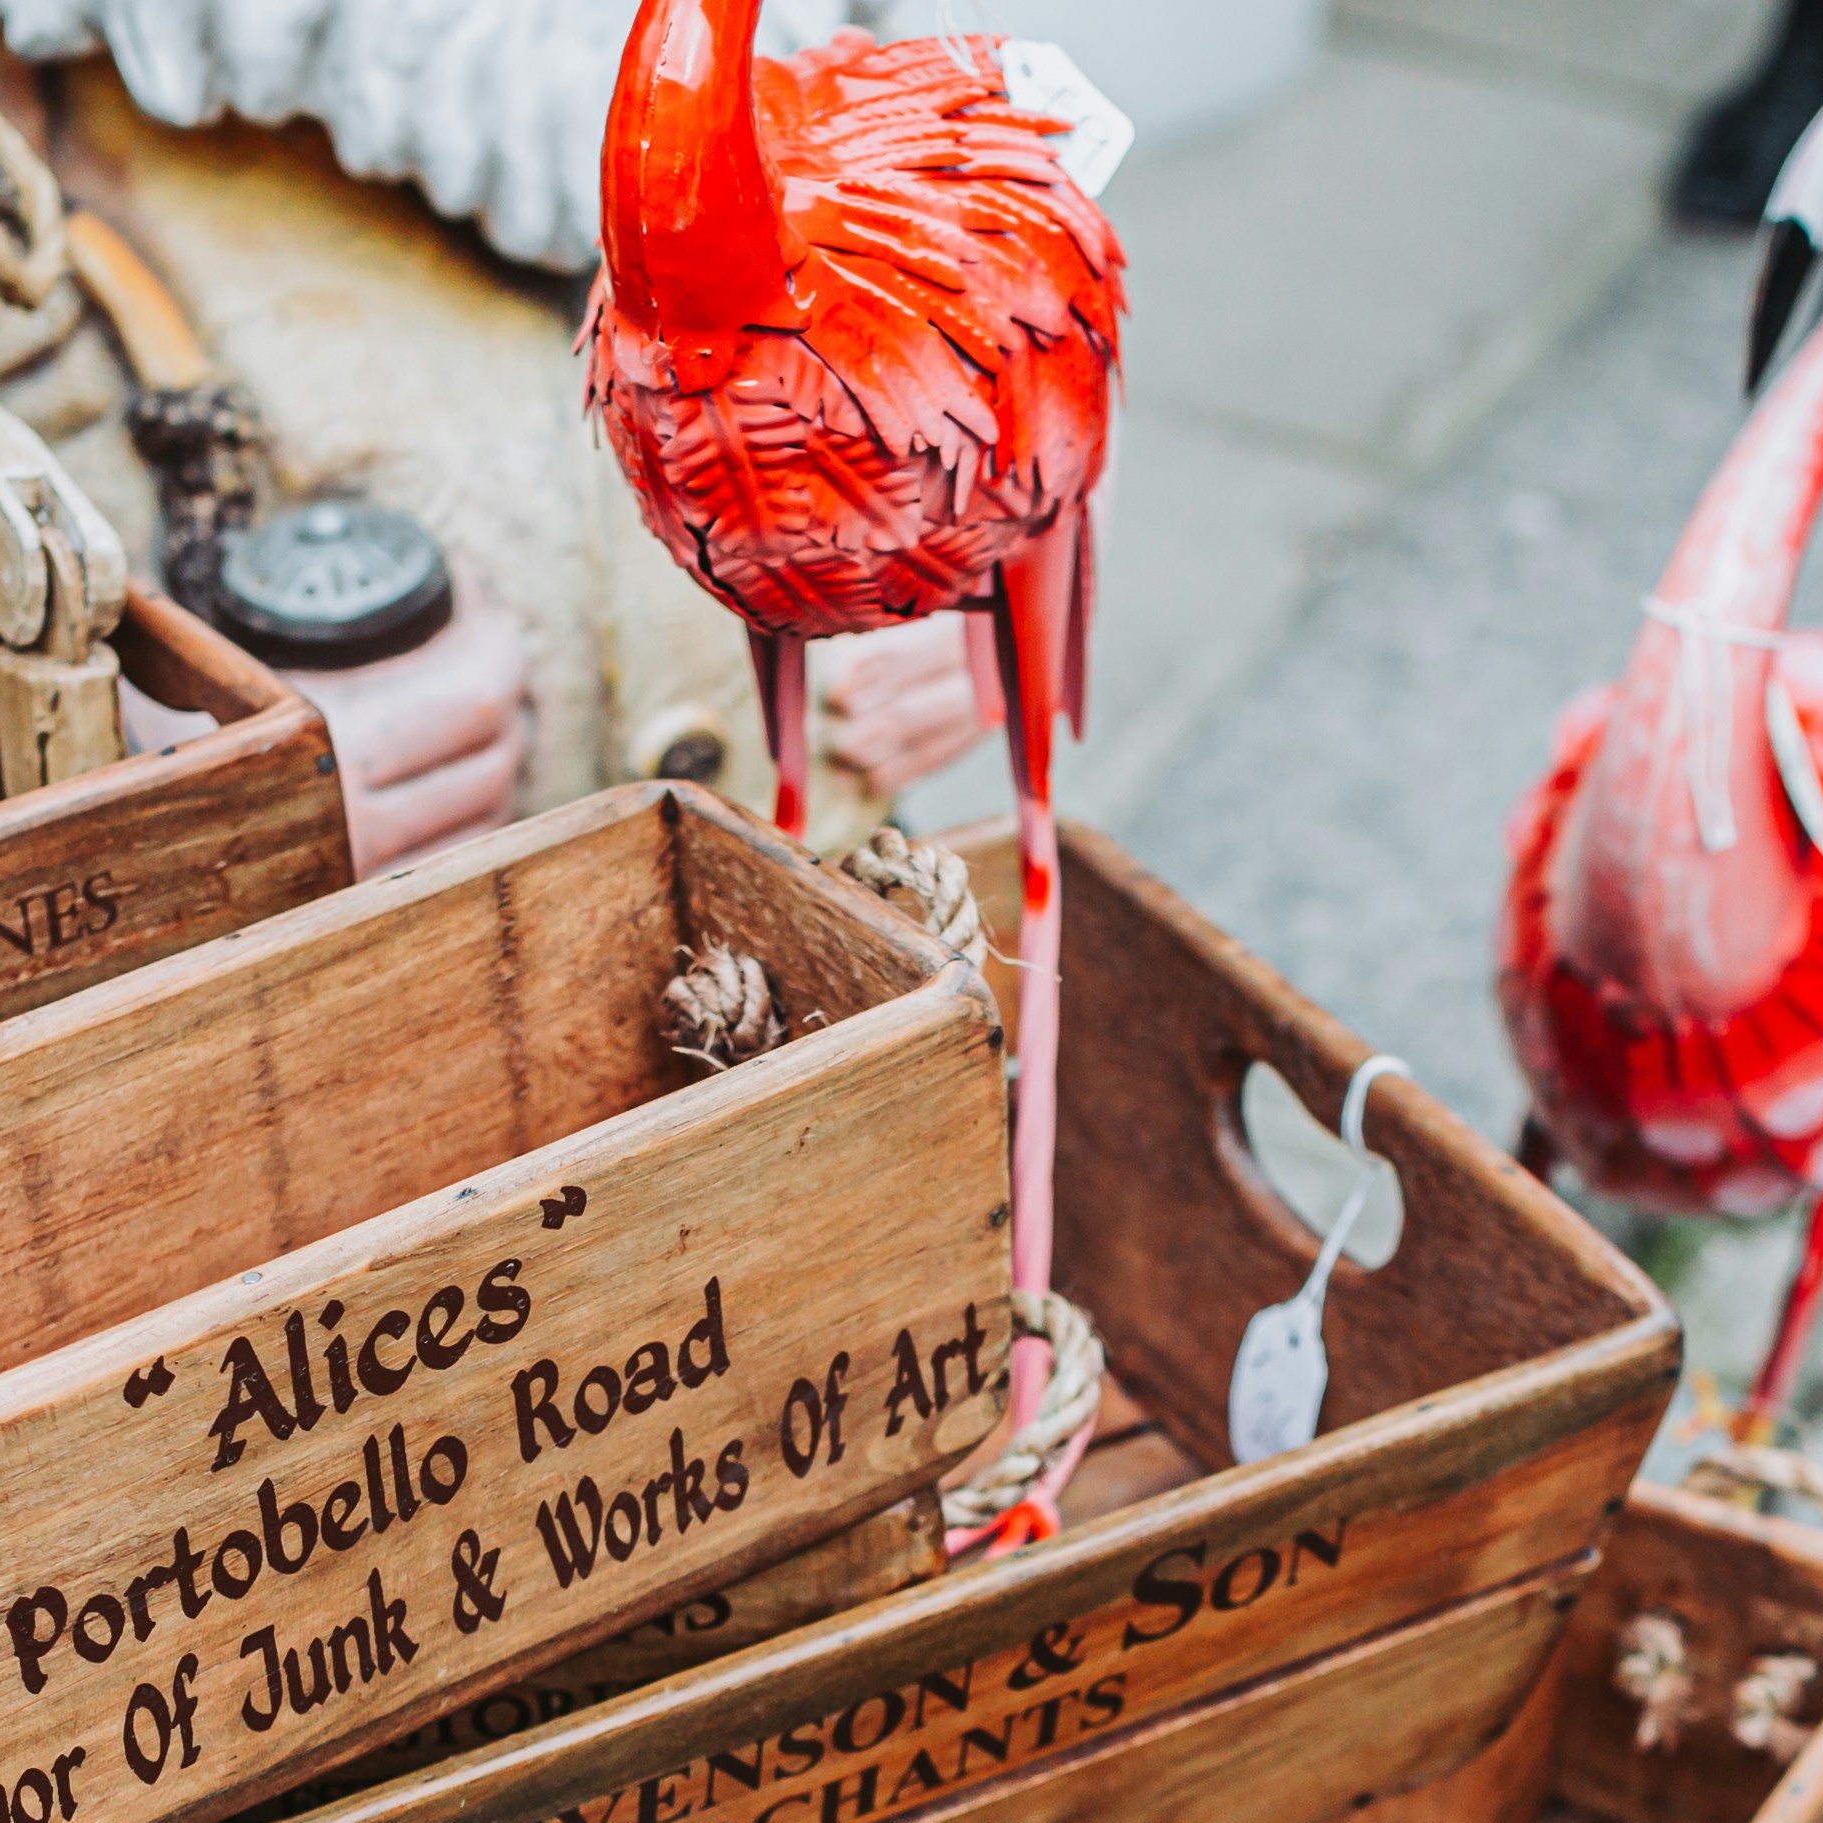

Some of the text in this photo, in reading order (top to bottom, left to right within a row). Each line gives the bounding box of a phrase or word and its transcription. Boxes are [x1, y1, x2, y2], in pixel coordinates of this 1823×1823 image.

[5, 1275, 732, 1694] Portobello Road
[122, 1653, 201, 1785] Of
[241, 1567, 419, 1731] Junk
[450, 1526, 507, 1635] &
[536, 1427, 749, 1590] Works
[780, 1351, 851, 1478] Of
[1006, 1621, 1085, 1693] &
[1122, 1517, 1349, 1654] SON
